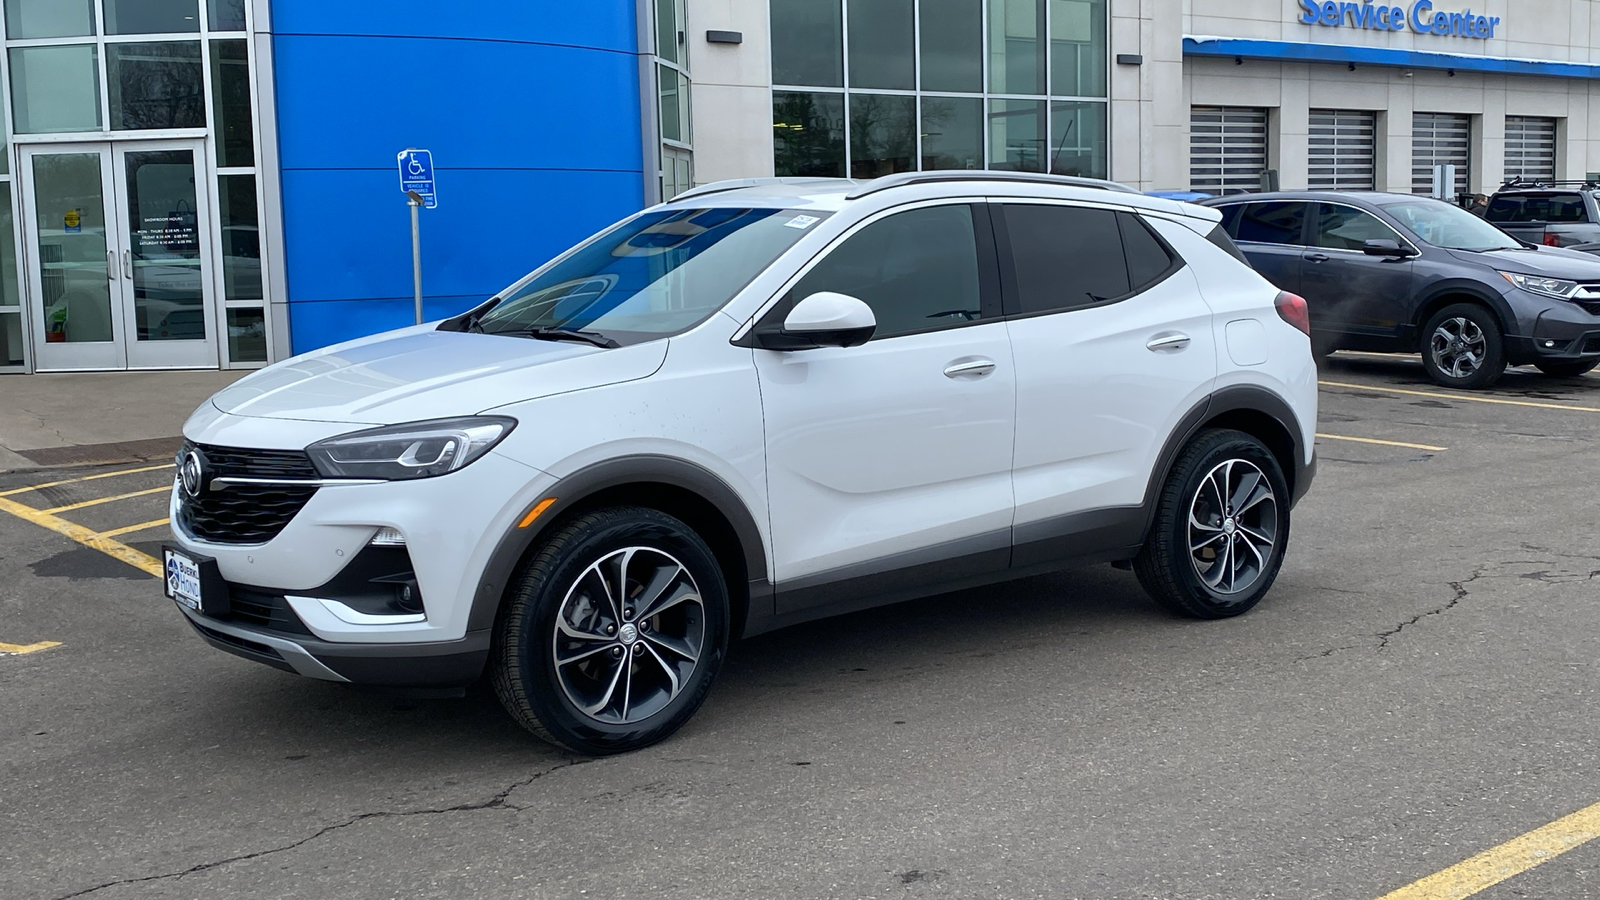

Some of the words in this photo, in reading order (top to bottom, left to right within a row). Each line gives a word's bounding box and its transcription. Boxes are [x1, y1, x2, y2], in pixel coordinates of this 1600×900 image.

[1298, 0, 1404, 31] Service
[1408, 0, 1500, 39] Center
[180, 561, 200, 579] BUERKL
[180, 573, 200, 598] HOND
